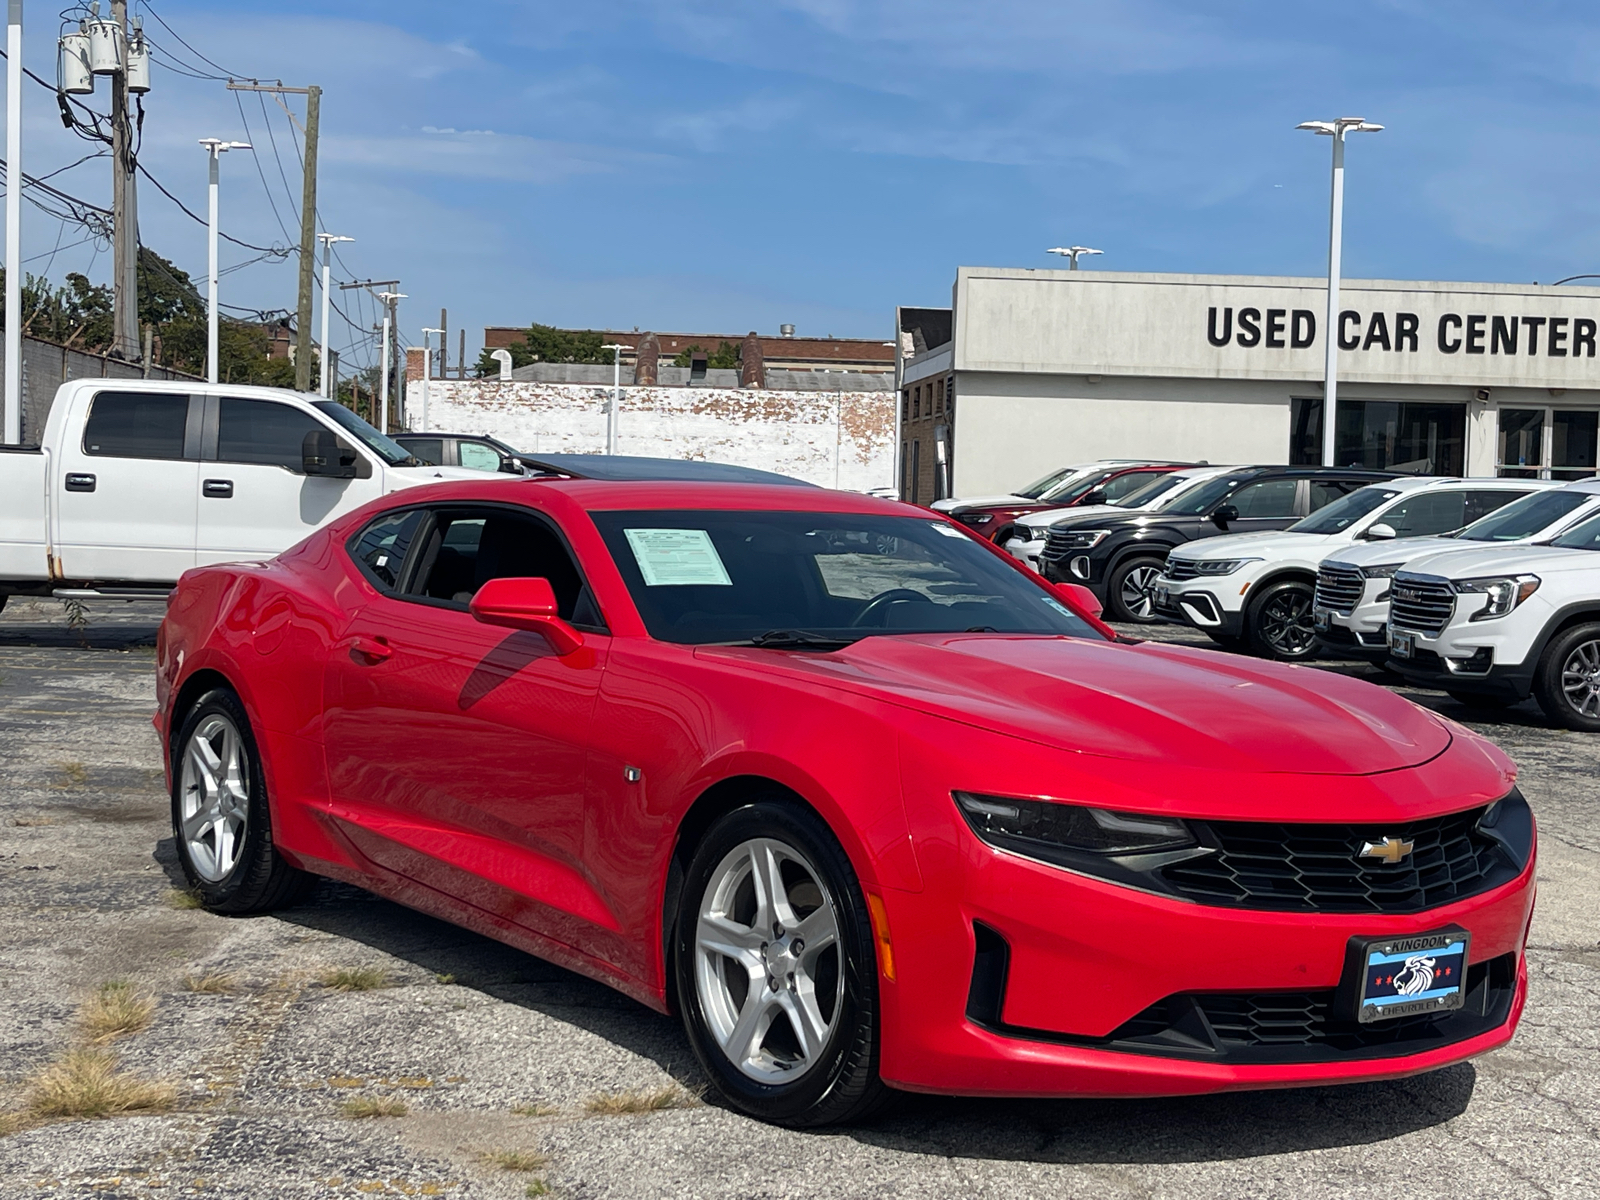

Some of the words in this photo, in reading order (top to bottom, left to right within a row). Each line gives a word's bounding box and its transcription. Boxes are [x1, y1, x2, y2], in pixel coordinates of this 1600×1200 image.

[1207, 307, 1316, 348] USED
[1337, 310, 1419, 352] CAR
[1437, 313, 1597, 357] CENTER
[1393, 936, 1447, 952] KINGDOM
[1383, 1001, 1438, 1016] CHEVROLET
